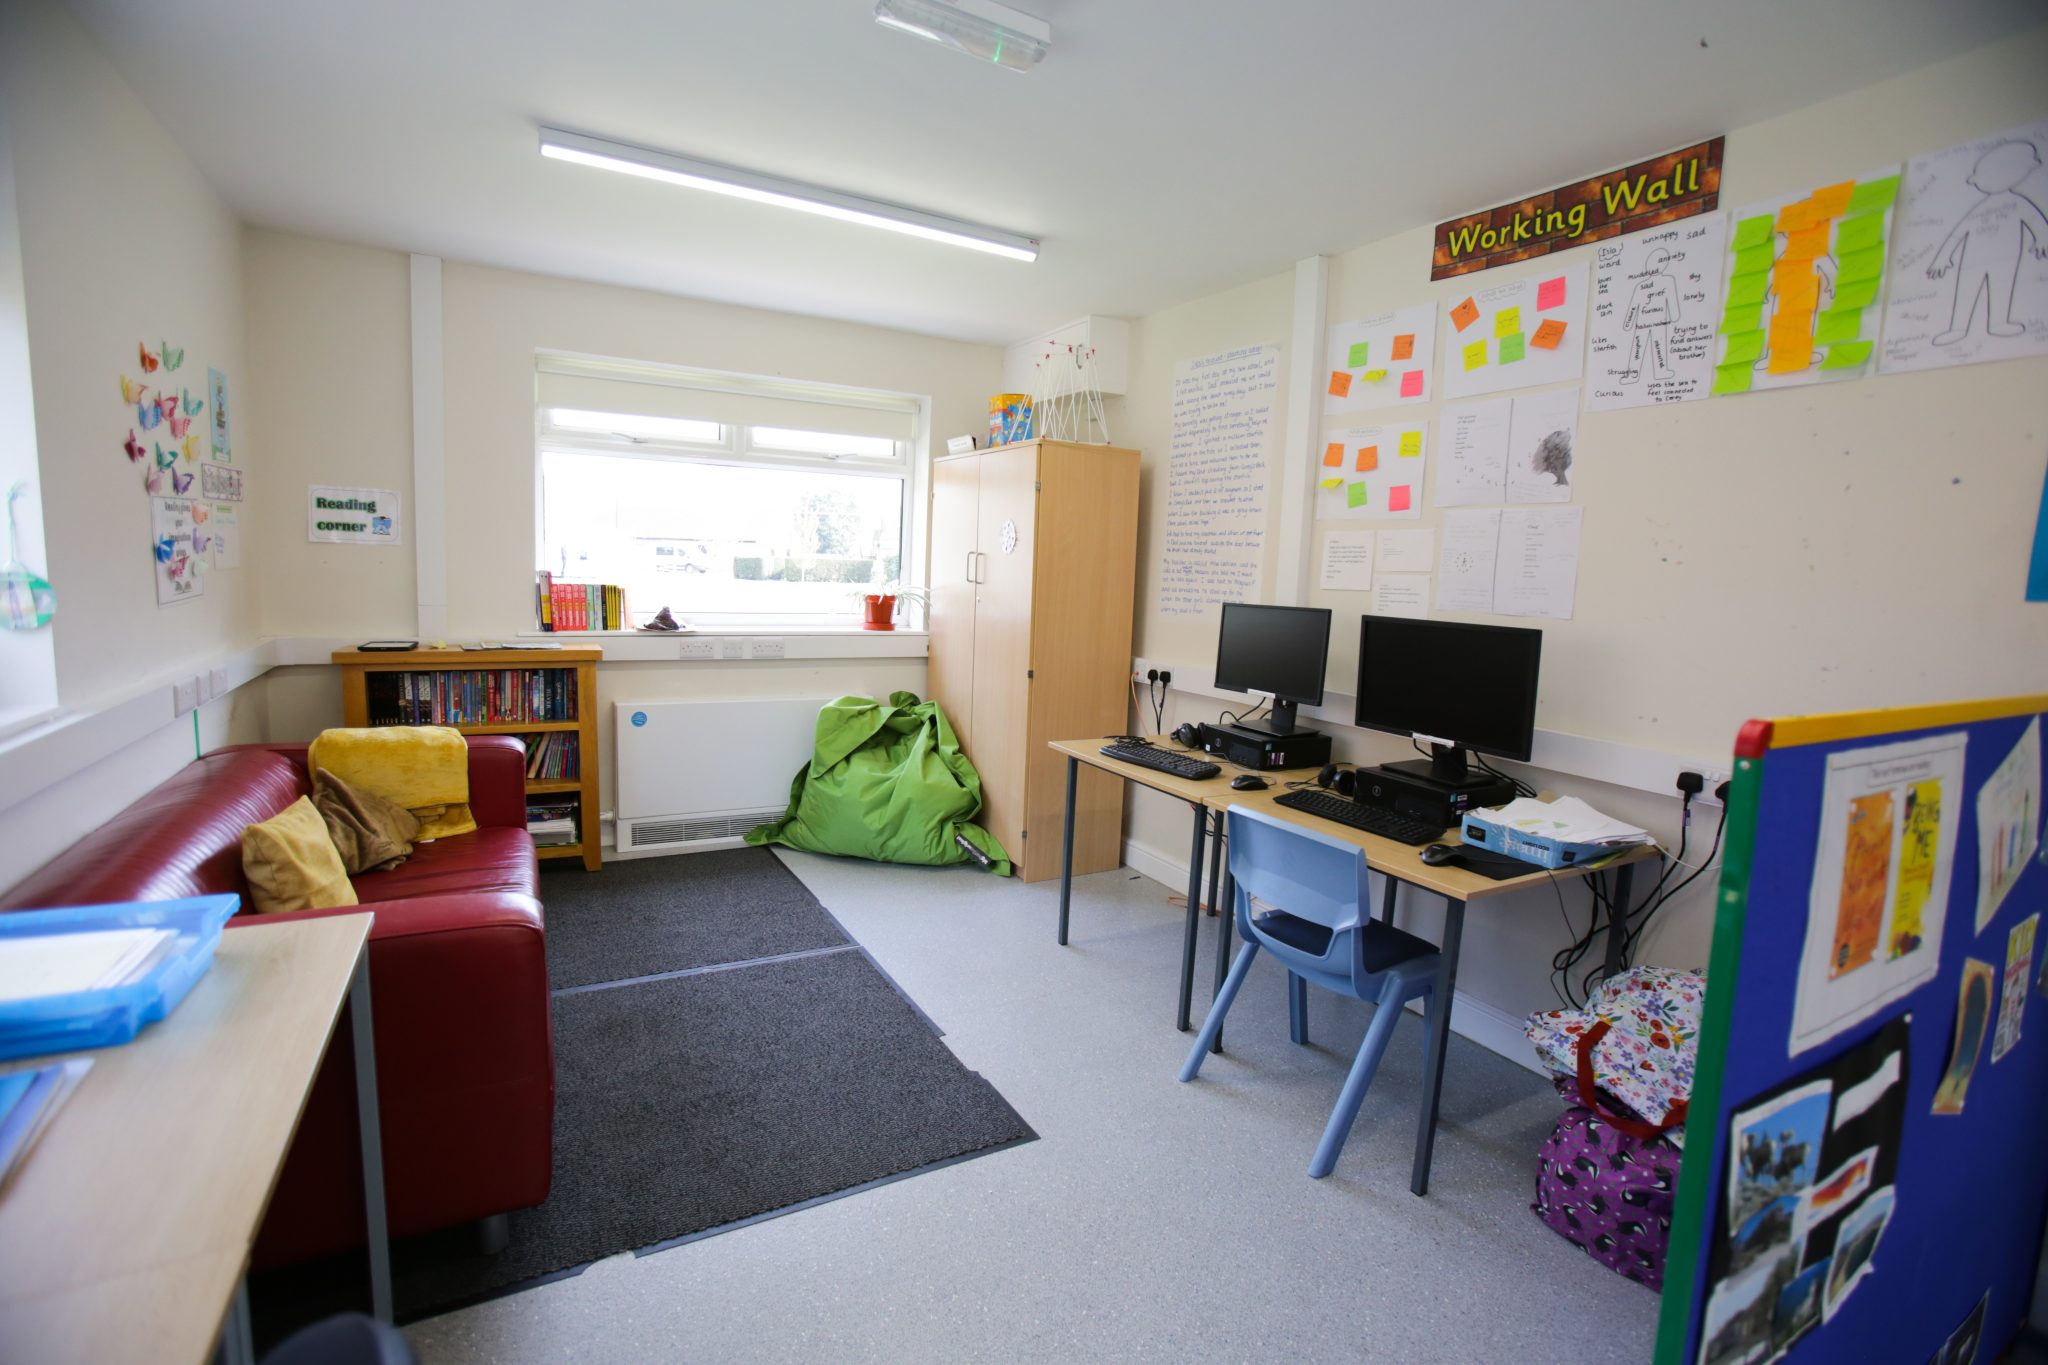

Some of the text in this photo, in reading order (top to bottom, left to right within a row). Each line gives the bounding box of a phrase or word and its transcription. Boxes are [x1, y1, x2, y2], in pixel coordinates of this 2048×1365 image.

[1449, 158, 1700, 257] Working Wall
[1687, 227, 1706, 239] sad
[1640, 282, 1654, 290] sad
[1683, 291, 1705, 302] lonely
[1674, 325, 1697, 337] trying
[316, 497, 376, 513] Reading
[316, 520, 366, 532] corner
